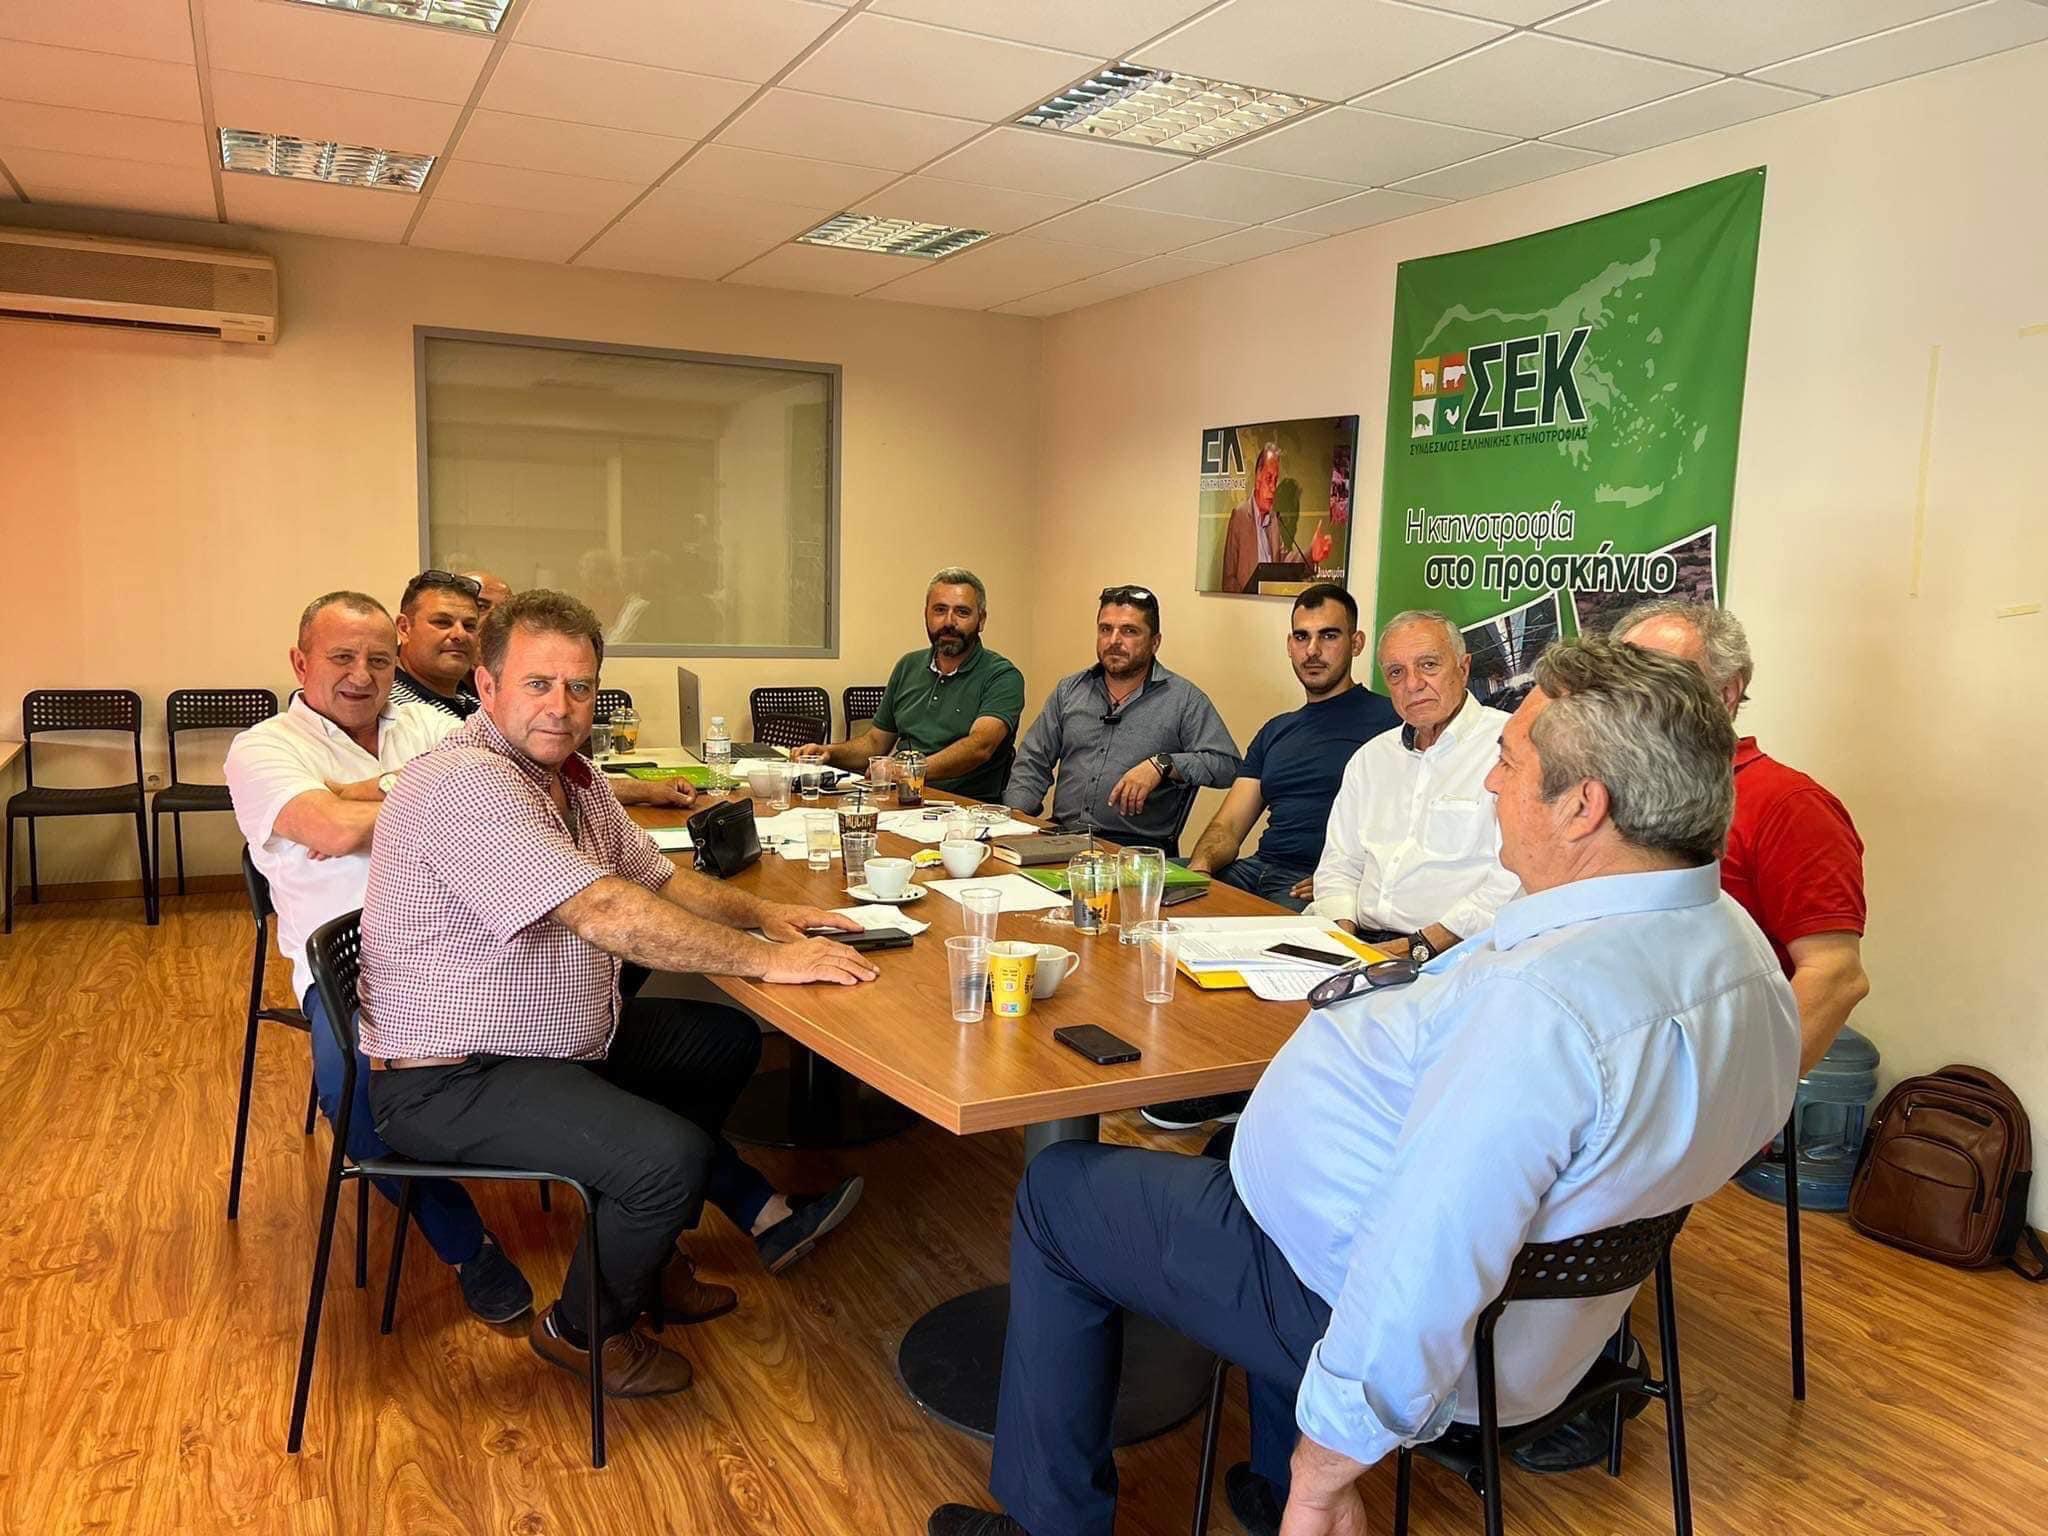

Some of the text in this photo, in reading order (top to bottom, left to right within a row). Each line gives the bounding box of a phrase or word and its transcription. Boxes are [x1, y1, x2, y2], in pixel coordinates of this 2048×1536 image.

[1463, 325, 1592, 434] ΣΕΚ
[1409, 426, 1588, 456] ΣΥΝΔΕΣΜΟΣ ΕΛΛΗΝΙΚΗΣ ΚΤΗΝΟΤΡΟΦΙΑΣ
[1405, 500, 1576, 550] Η κτηνοτροφία
[1424, 541, 1679, 602] στο προσκήνιο
